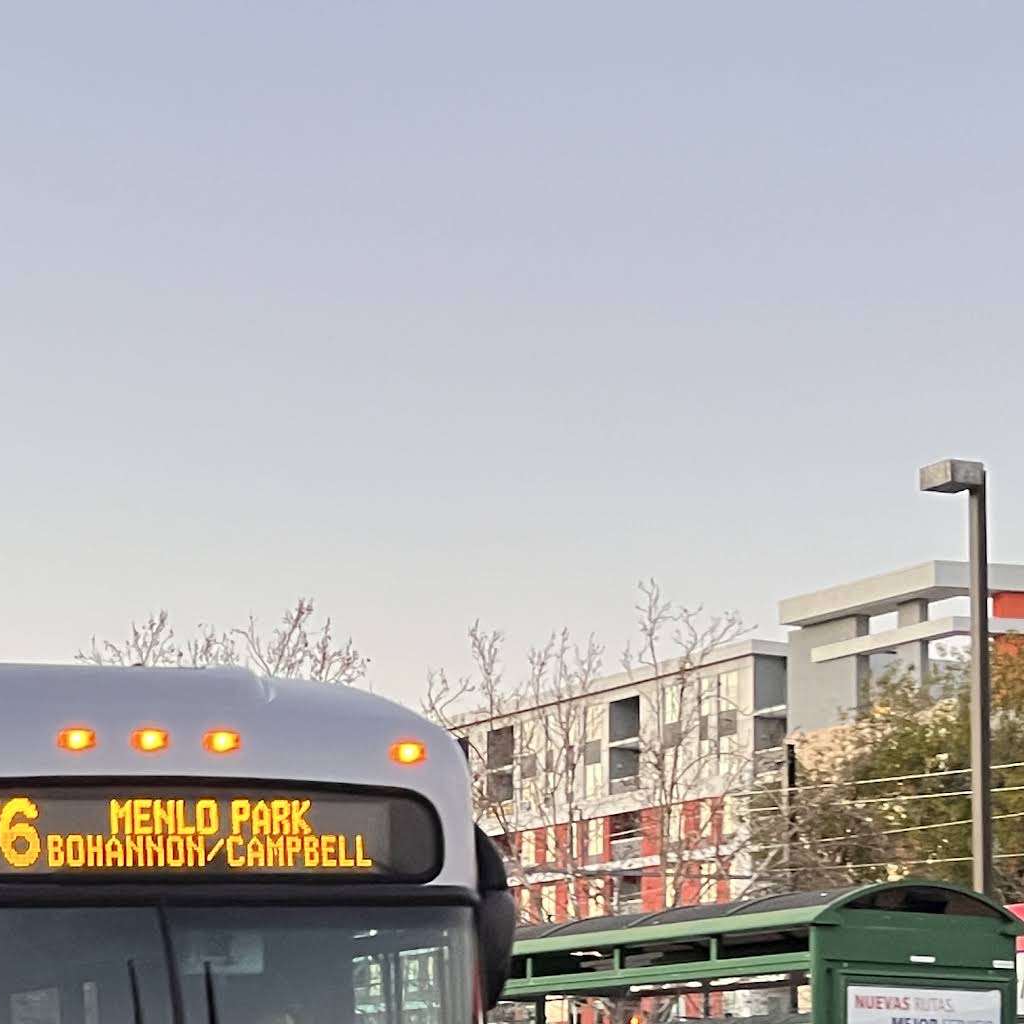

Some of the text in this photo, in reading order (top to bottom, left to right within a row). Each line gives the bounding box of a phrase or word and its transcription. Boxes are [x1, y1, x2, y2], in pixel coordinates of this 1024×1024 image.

[109, 799, 312, 835] MENLO PARK
[47, 834, 373, 868] BOHANNON/CAMPBELL
[854, 994, 910, 1011] NUEVAS
